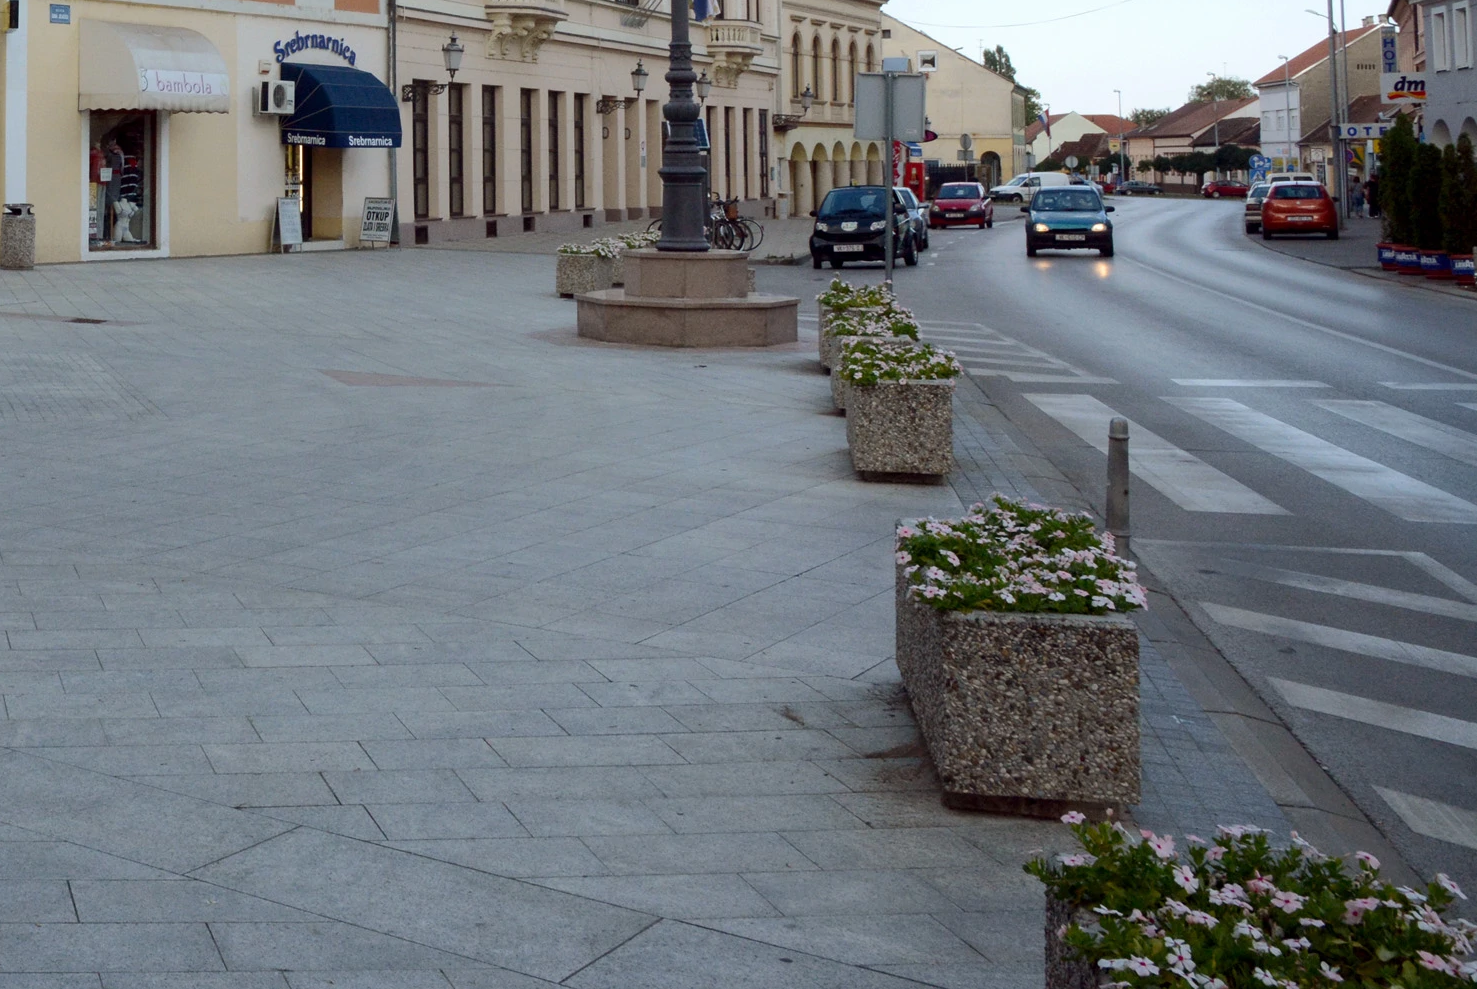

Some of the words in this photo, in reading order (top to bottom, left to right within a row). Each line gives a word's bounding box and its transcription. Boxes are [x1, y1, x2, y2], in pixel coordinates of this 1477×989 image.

[273, 30, 356, 66] Srebrnarnica
[156, 71, 212, 94] bambola
[1394, 76, 1426, 92] dm
[1339, 126, 1388, 136] OTE
[287, 133, 326, 145] Srebrnarnica
[348, 135, 393, 146] Srebrnarnica
[366, 211, 390, 221] OTKUP
